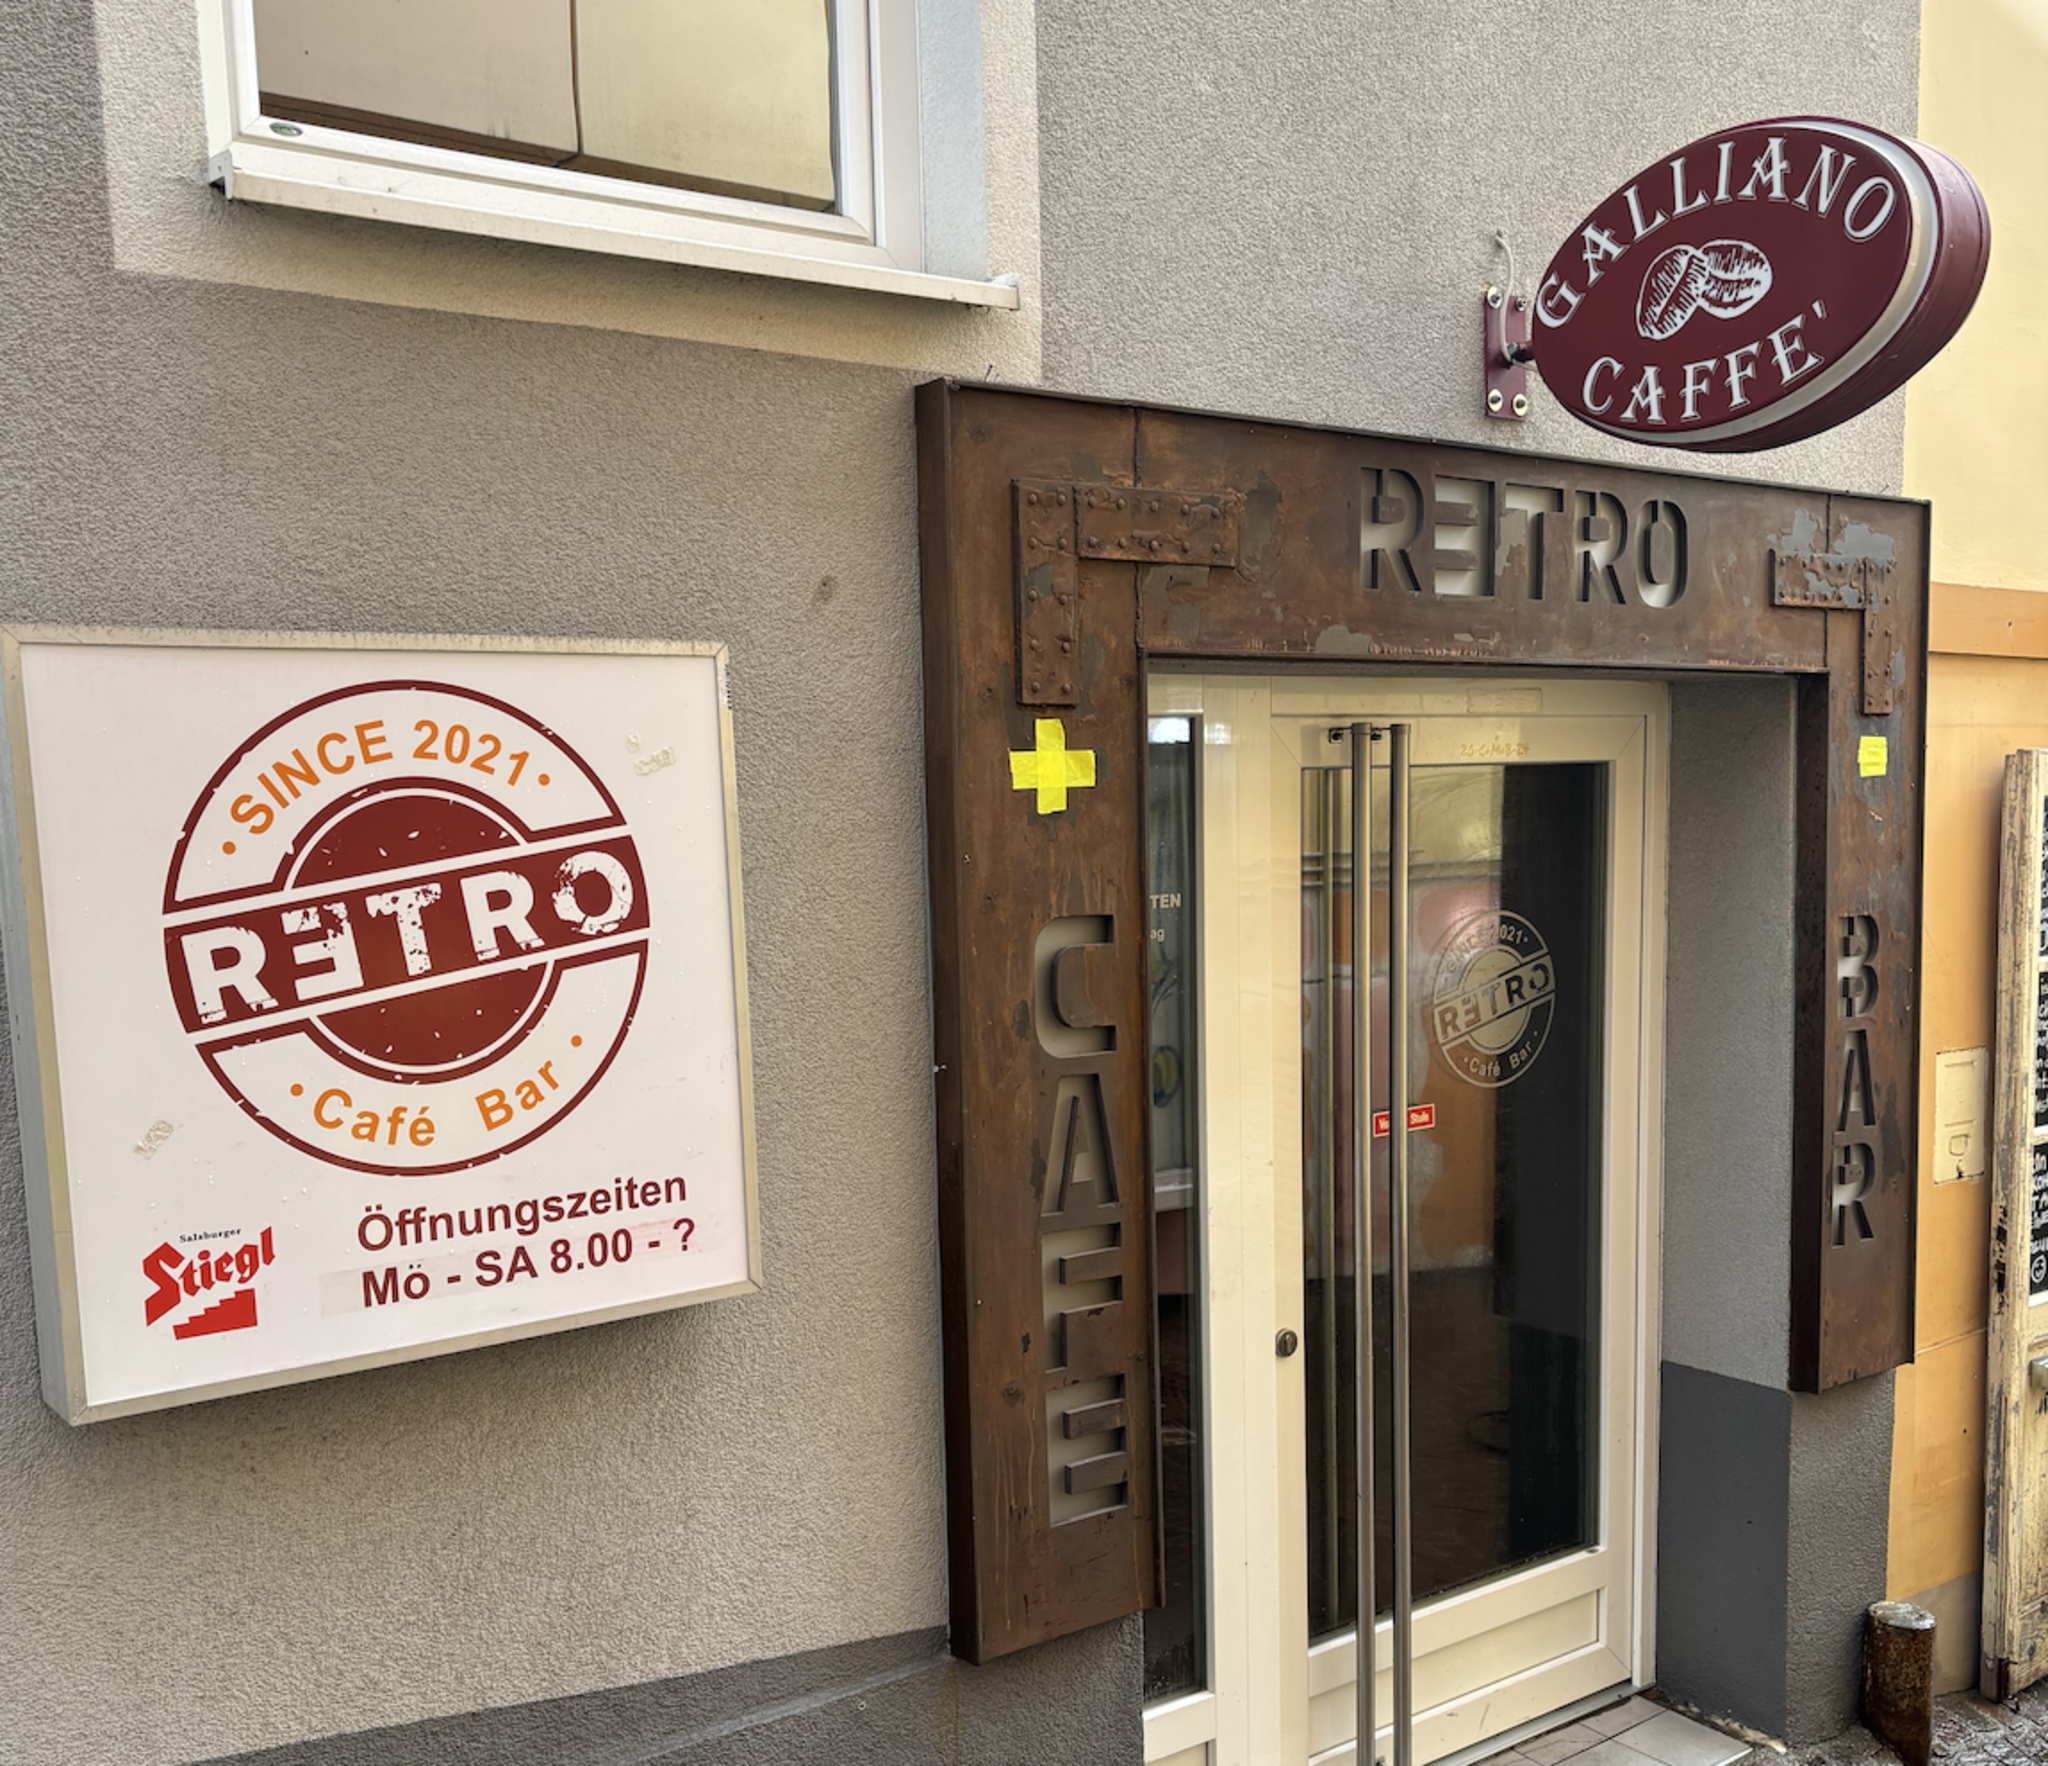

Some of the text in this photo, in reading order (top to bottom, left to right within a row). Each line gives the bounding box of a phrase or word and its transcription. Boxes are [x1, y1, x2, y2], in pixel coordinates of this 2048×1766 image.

[1535, 137, 1896, 328] GALLIANO
[1360, 467, 1687, 609] RETRO
[230, 720, 530, 835] SINCE 2021
[180, 851, 633, 1024] RETRO
[1438, 963, 1549, 1040] RETRO
[313, 1060, 560, 1146] Café Bar
[1469, 1041, 1532, 1077] Café Bar
[1832, 914, 1879, 1249] BAR
[179, 1228, 242, 1243] Salzburger
[357, 1176, 687, 1251] Öffnungszeiten
[362, 1263, 431, 1308] Mö
[475, 1245, 538, 1288] SA
[550, 1229, 633, 1273] 8.00
[673, 1217, 696, 1251] ?
[1034, 914, 1128, 1528] CAFE
[142, 1226, 276, 1327] Stiegl
